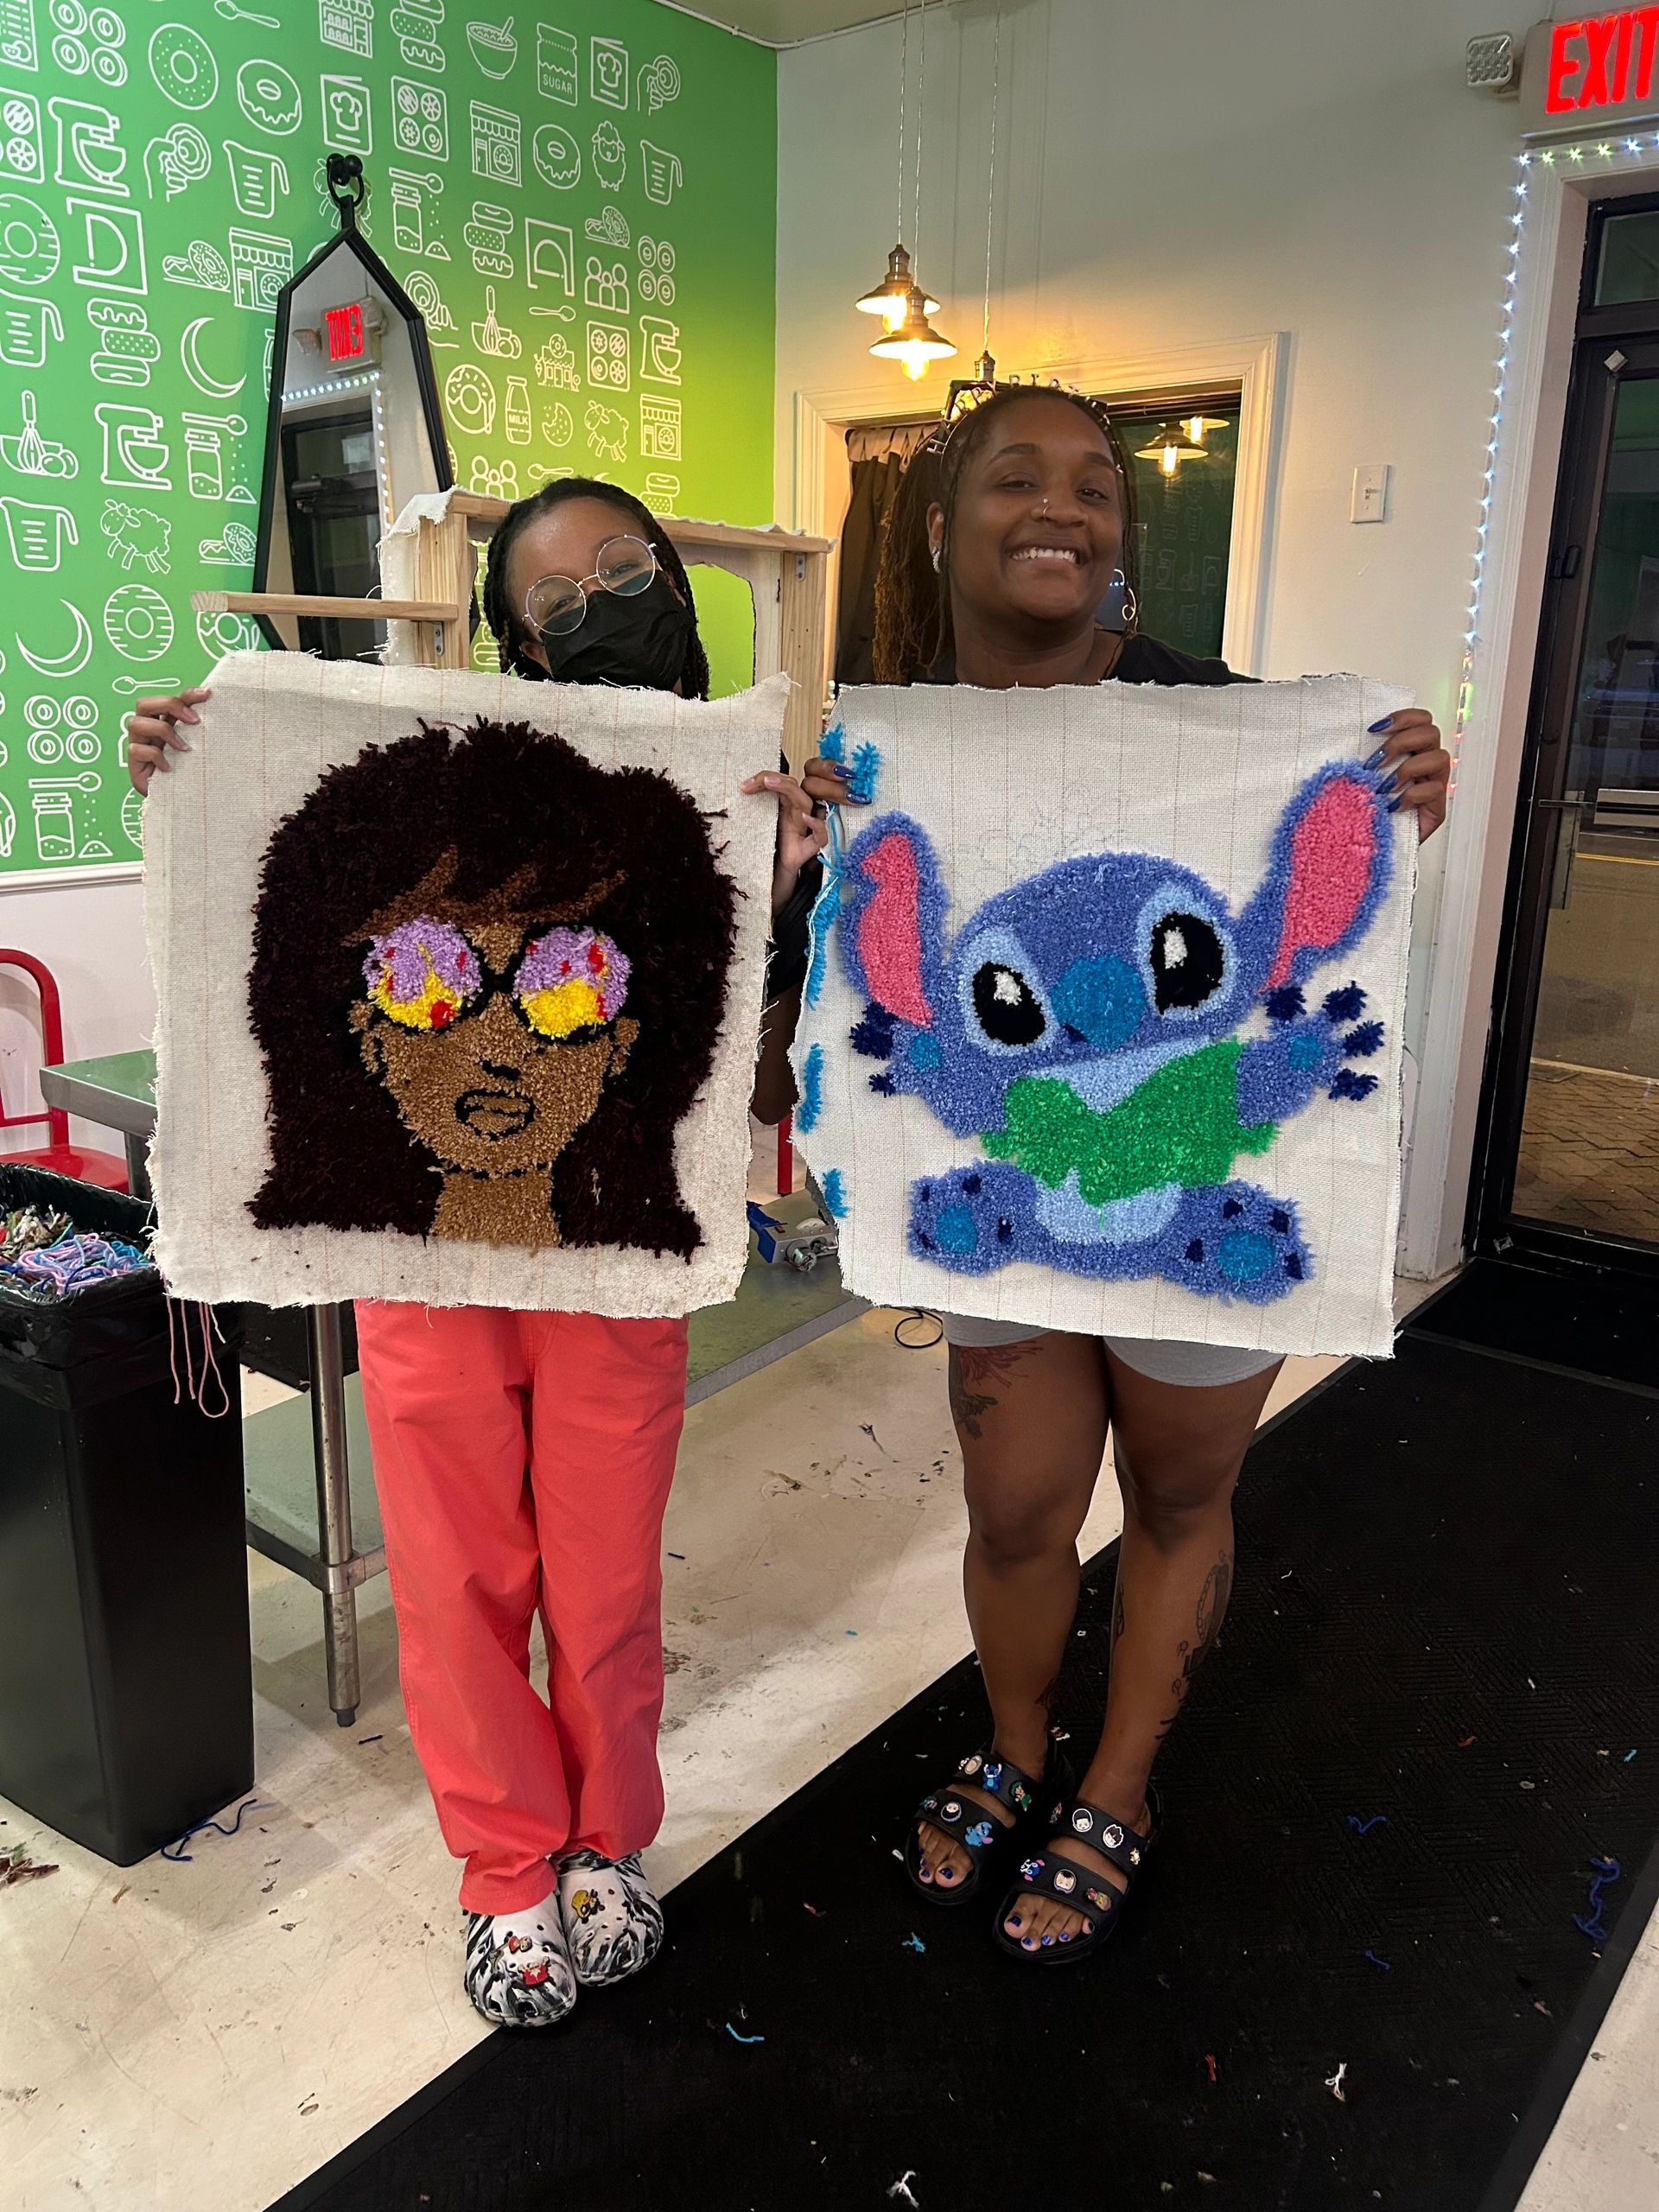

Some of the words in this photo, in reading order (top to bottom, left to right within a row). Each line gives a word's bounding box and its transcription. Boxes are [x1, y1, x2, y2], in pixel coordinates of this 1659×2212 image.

[1545, 5, 1659, 113] EXIT
[543, 74, 572, 95] SUGAR
[508, 415, 528, 426] MILK
